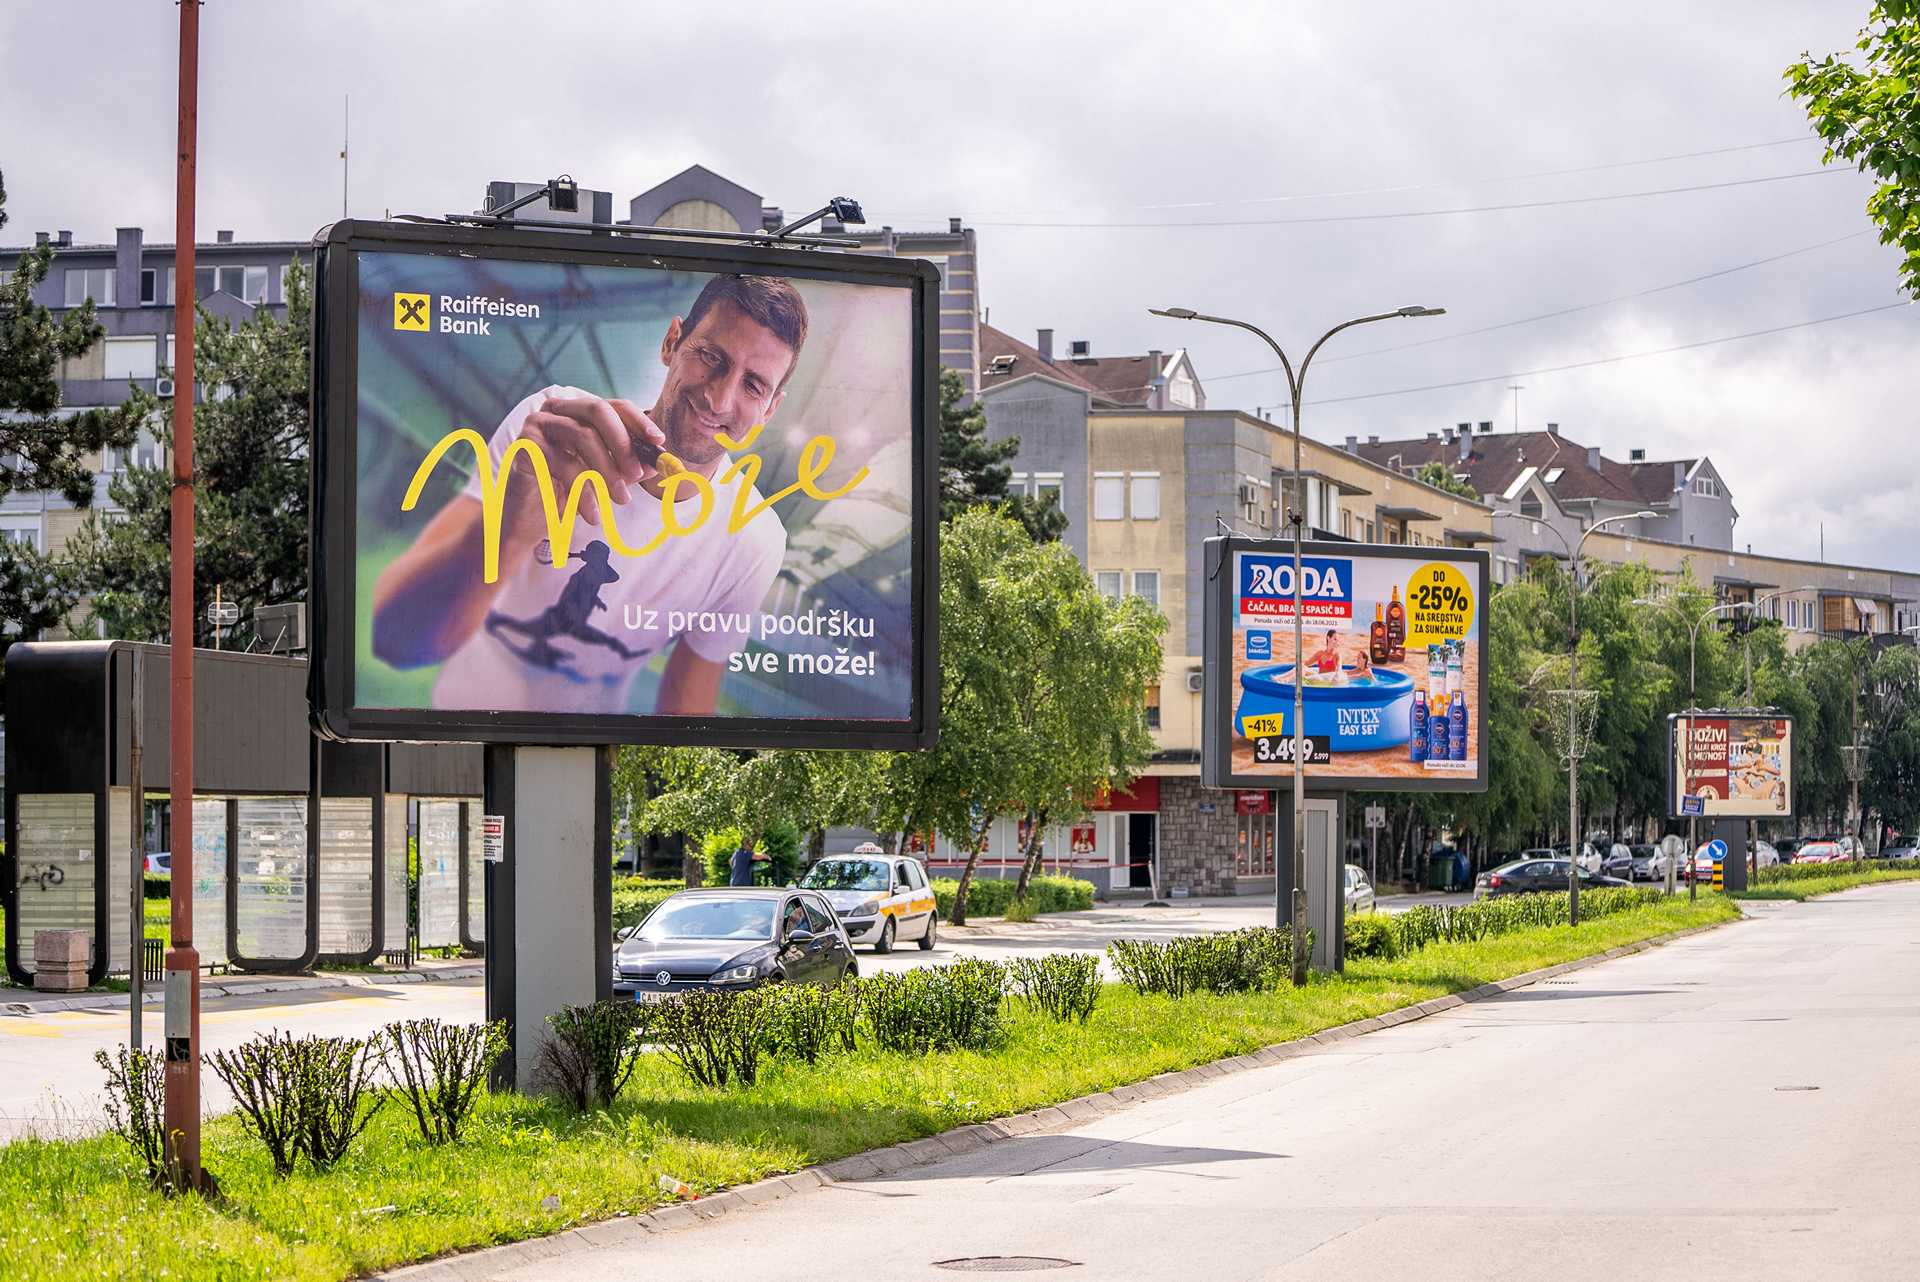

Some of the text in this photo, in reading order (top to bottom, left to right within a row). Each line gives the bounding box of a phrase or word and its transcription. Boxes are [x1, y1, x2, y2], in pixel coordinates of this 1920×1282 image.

[440, 295, 540, 318] Raiffeisen
[440, 316, 490, 335] Bank
[1248, 564, 1344, 598] RODA
[1433, 570, 1445, 582] DO
[1410, 585, 1468, 611] -25%
[1247, 601, 1345, 615] ČAČAK, BRAE SPASIĆ BB
[623, 604, 875, 640] Uz pravu podršku
[1415, 612, 1463, 623] NA SREDSTVA
[1414, 623, 1463, 635] ZA SUNČANJE
[729, 648, 875, 676] sve može!
[1337, 708, 1379, 724] INTEX
[1248, 719, 1277, 733] -41%
[1340, 725, 1378, 736] EASY SET
[1257, 738, 1314, 761] 3.499
